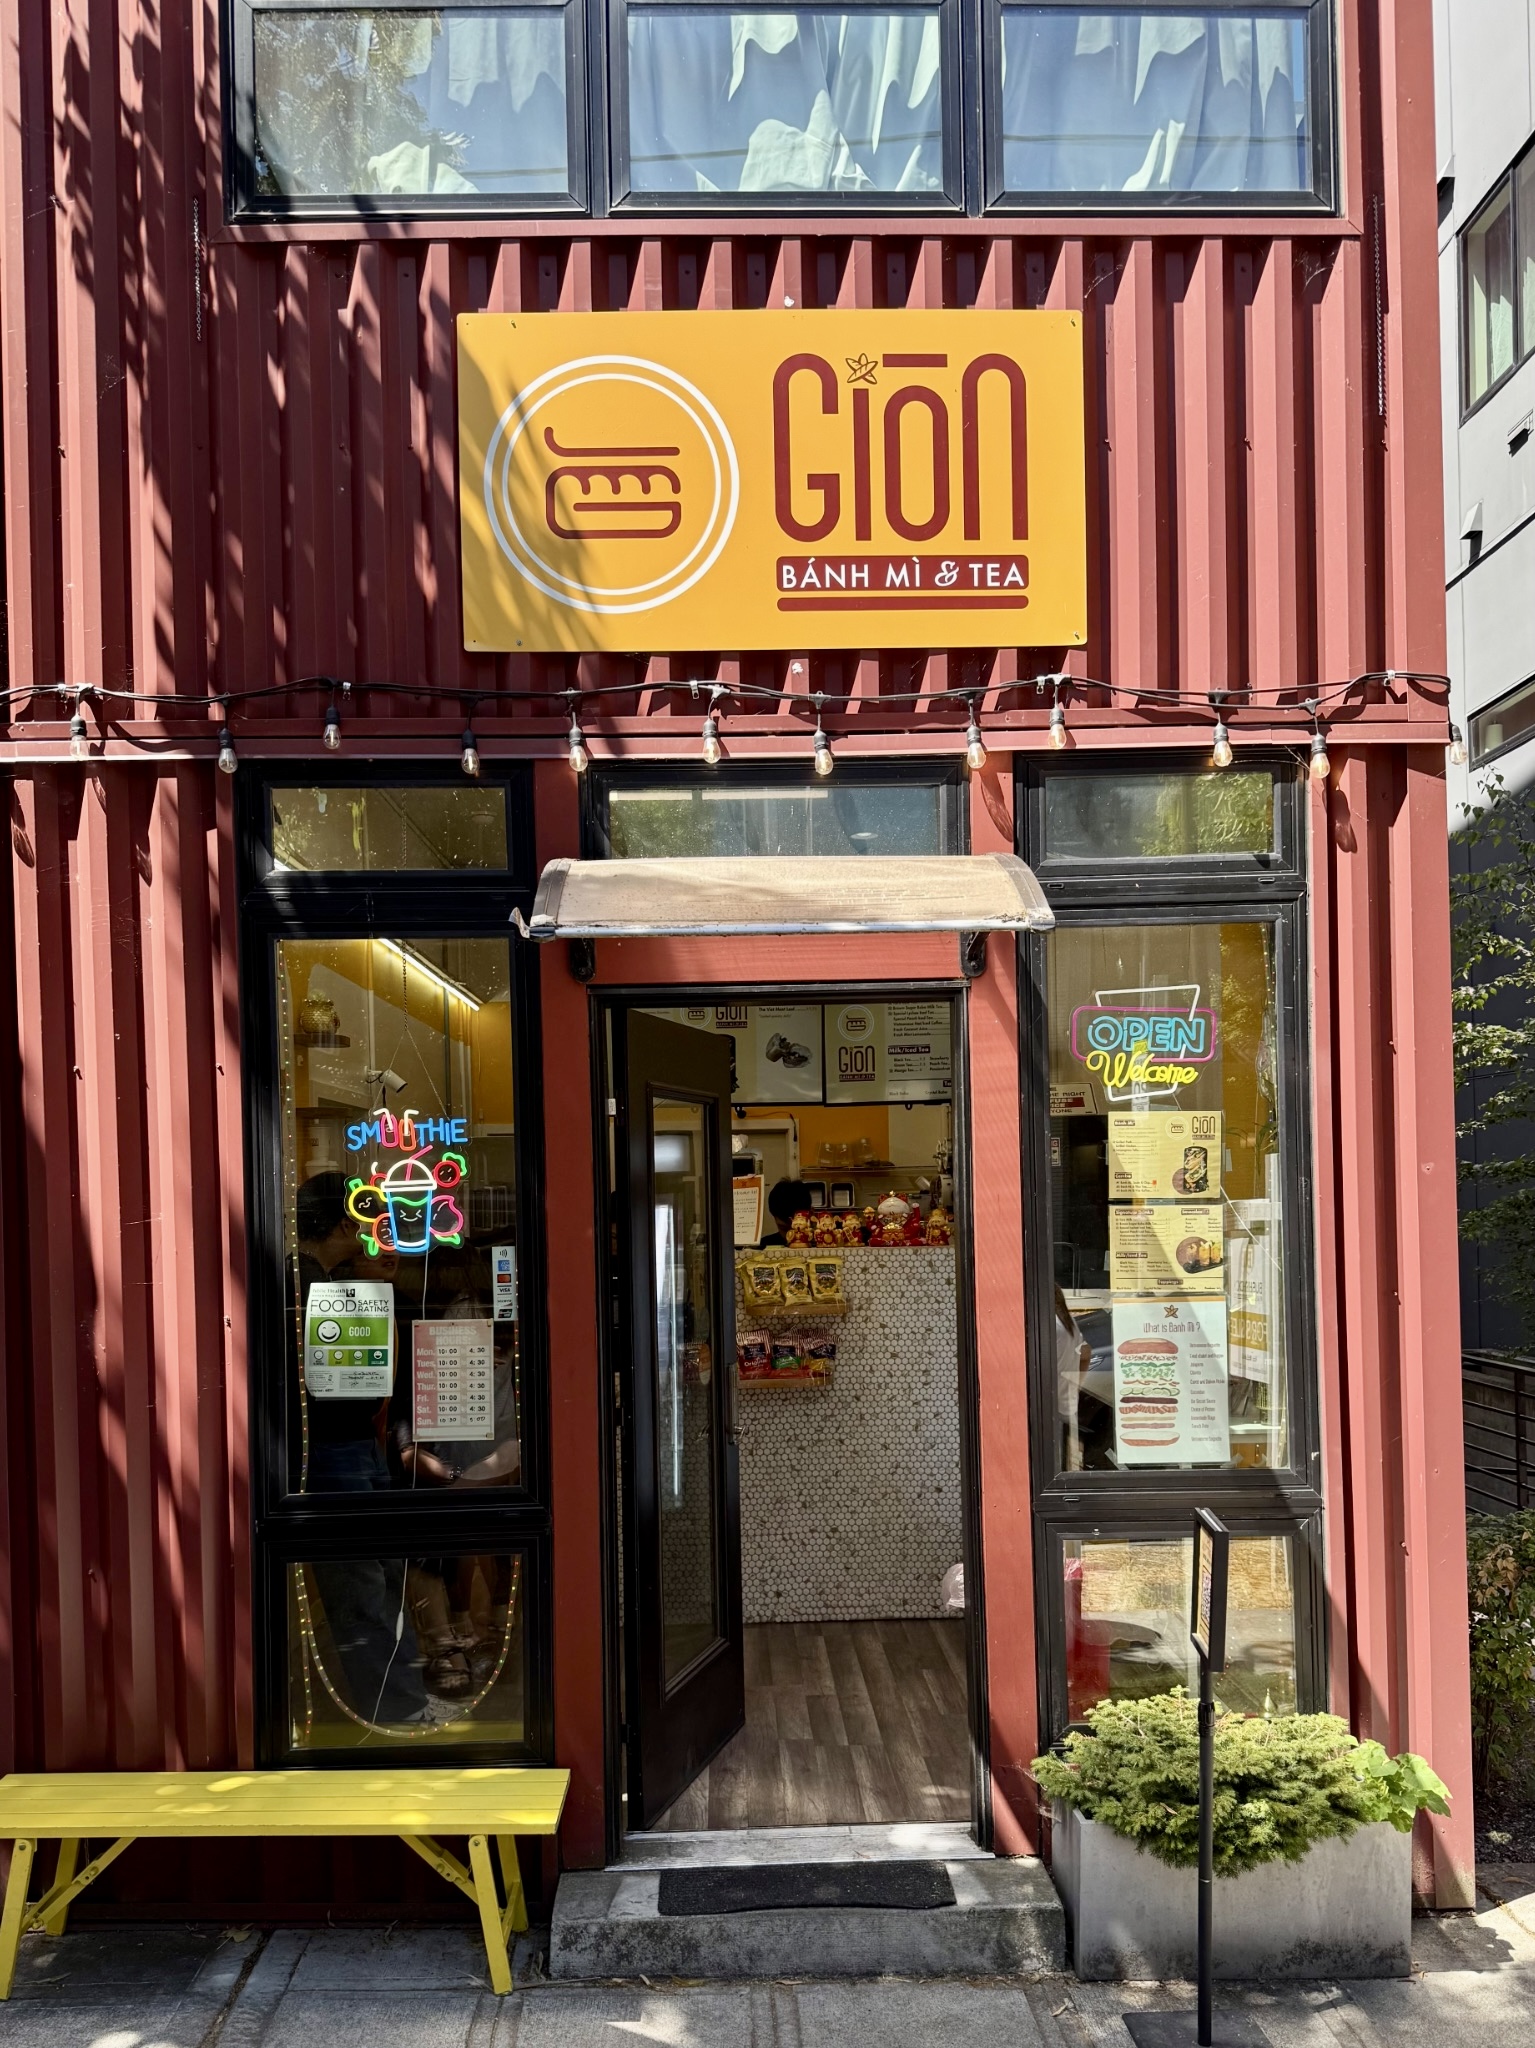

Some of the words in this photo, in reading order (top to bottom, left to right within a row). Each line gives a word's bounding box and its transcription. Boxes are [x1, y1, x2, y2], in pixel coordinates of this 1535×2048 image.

[782, 556, 870, 589] BÁNH
[885, 556, 921, 588] MÌ
[935, 561, 960, 587] &
[968, 562, 1025, 588] TEA
[1087, 1015, 1206, 1053] OPEN
[1085, 1050, 1199, 1089] Welcome
[347, 1113, 469, 1151] SMOOTHIE
[310, 1299, 357, 1313] FOOD
[348, 1326, 371, 1337] GOOD
[429, 1326, 478, 1336] BUSINESS
[1143, 1322, 1160, 1333] What
[416, 1348, 435, 1356] Mon.
[416, 1360, 436, 1368] Tues.
[416, 1371, 436, 1379] Wed.
[416, 1394, 429, 1402] Fri.
[416, 1406, 432, 1414] Sat.
[416, 1417, 434, 1426] Sun.
